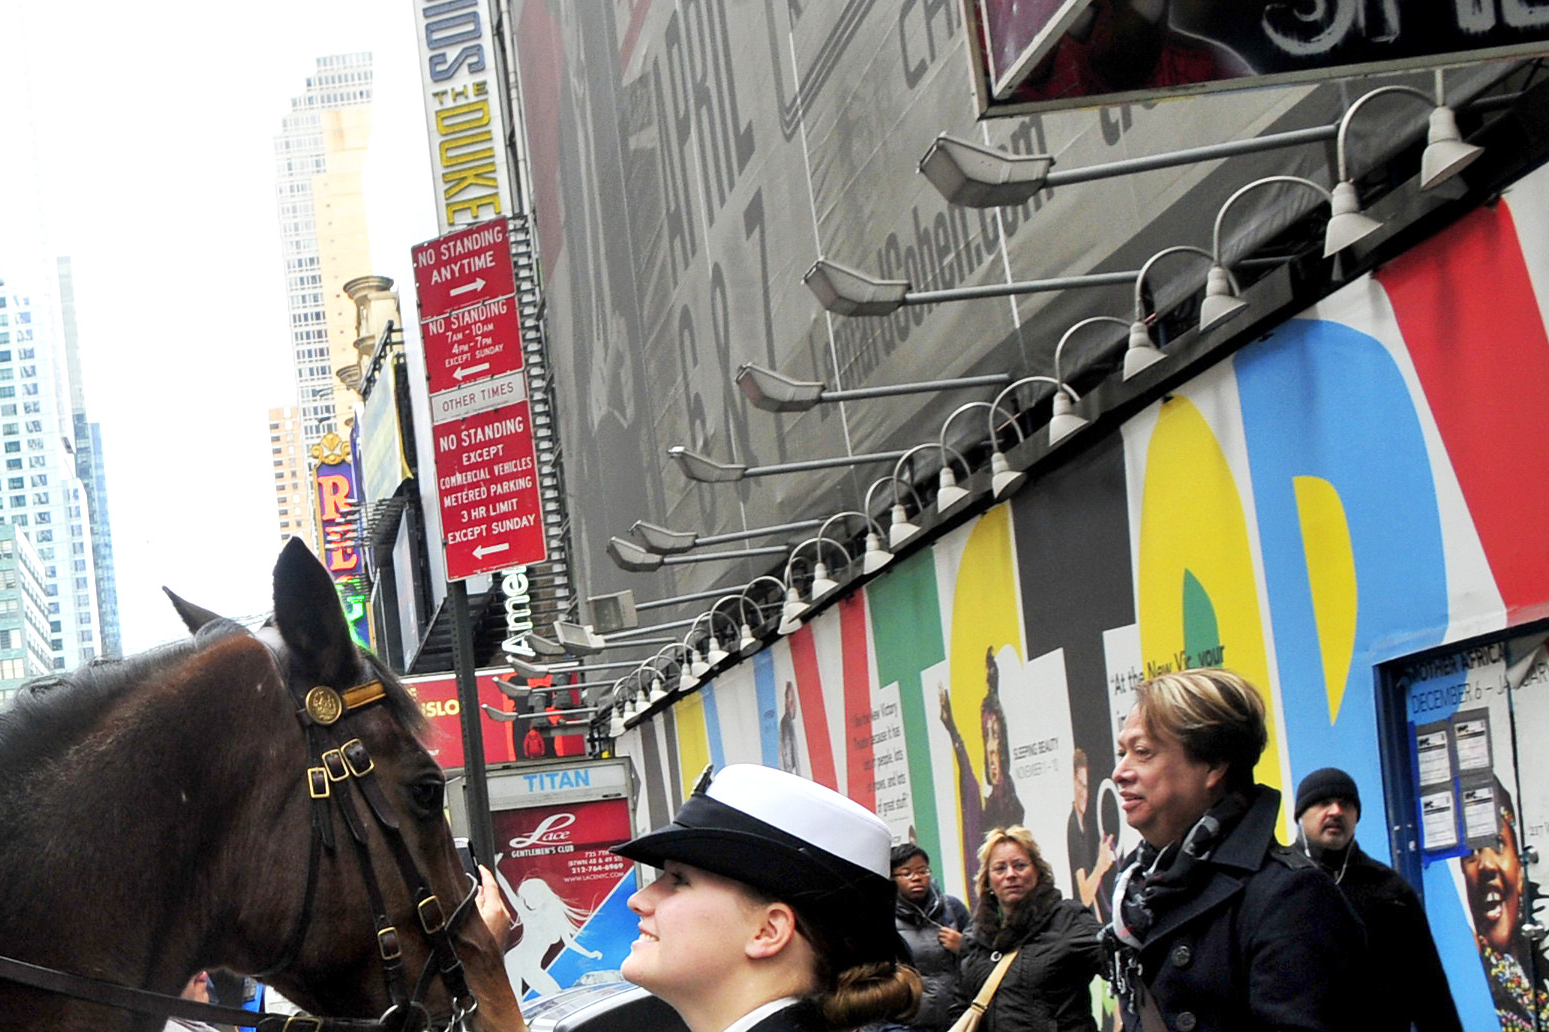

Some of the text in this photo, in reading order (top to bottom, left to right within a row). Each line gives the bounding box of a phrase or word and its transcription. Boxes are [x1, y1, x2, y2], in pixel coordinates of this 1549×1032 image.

[432, 80, 489, 105] THE
[435, 98, 501, 226] DUKE
[418, 226, 503, 268] NO STANDING
[431, 251, 496, 285] ANYTIME
[429, 299, 508, 336] NO STANDING
[445, 343, 505, 368] EXCEPT SUNDAY
[442, 381, 514, 413] OTHER TIMES
[439, 416, 524, 453] NO STANDING
[462, 444, 504, 466] EXCEPT
[440, 456, 533, 490] COMMERCIAL VEHICLES
[444, 476, 533, 509] METERED PARKING
[461, 498, 518, 523] 3 HR LIMIT
[447, 513, 536, 545] EXCEPT SUNDAY
[1147, 659, 1173, 681] New
[1410, 682, 1472, 714] DECEMBER
[1474, 680, 1482, 699] 6
[523, 768, 591, 792] TITAN
[509, 812, 576, 848] Lace
[511, 844, 574, 858] GENTLEMEN'S CLUB
